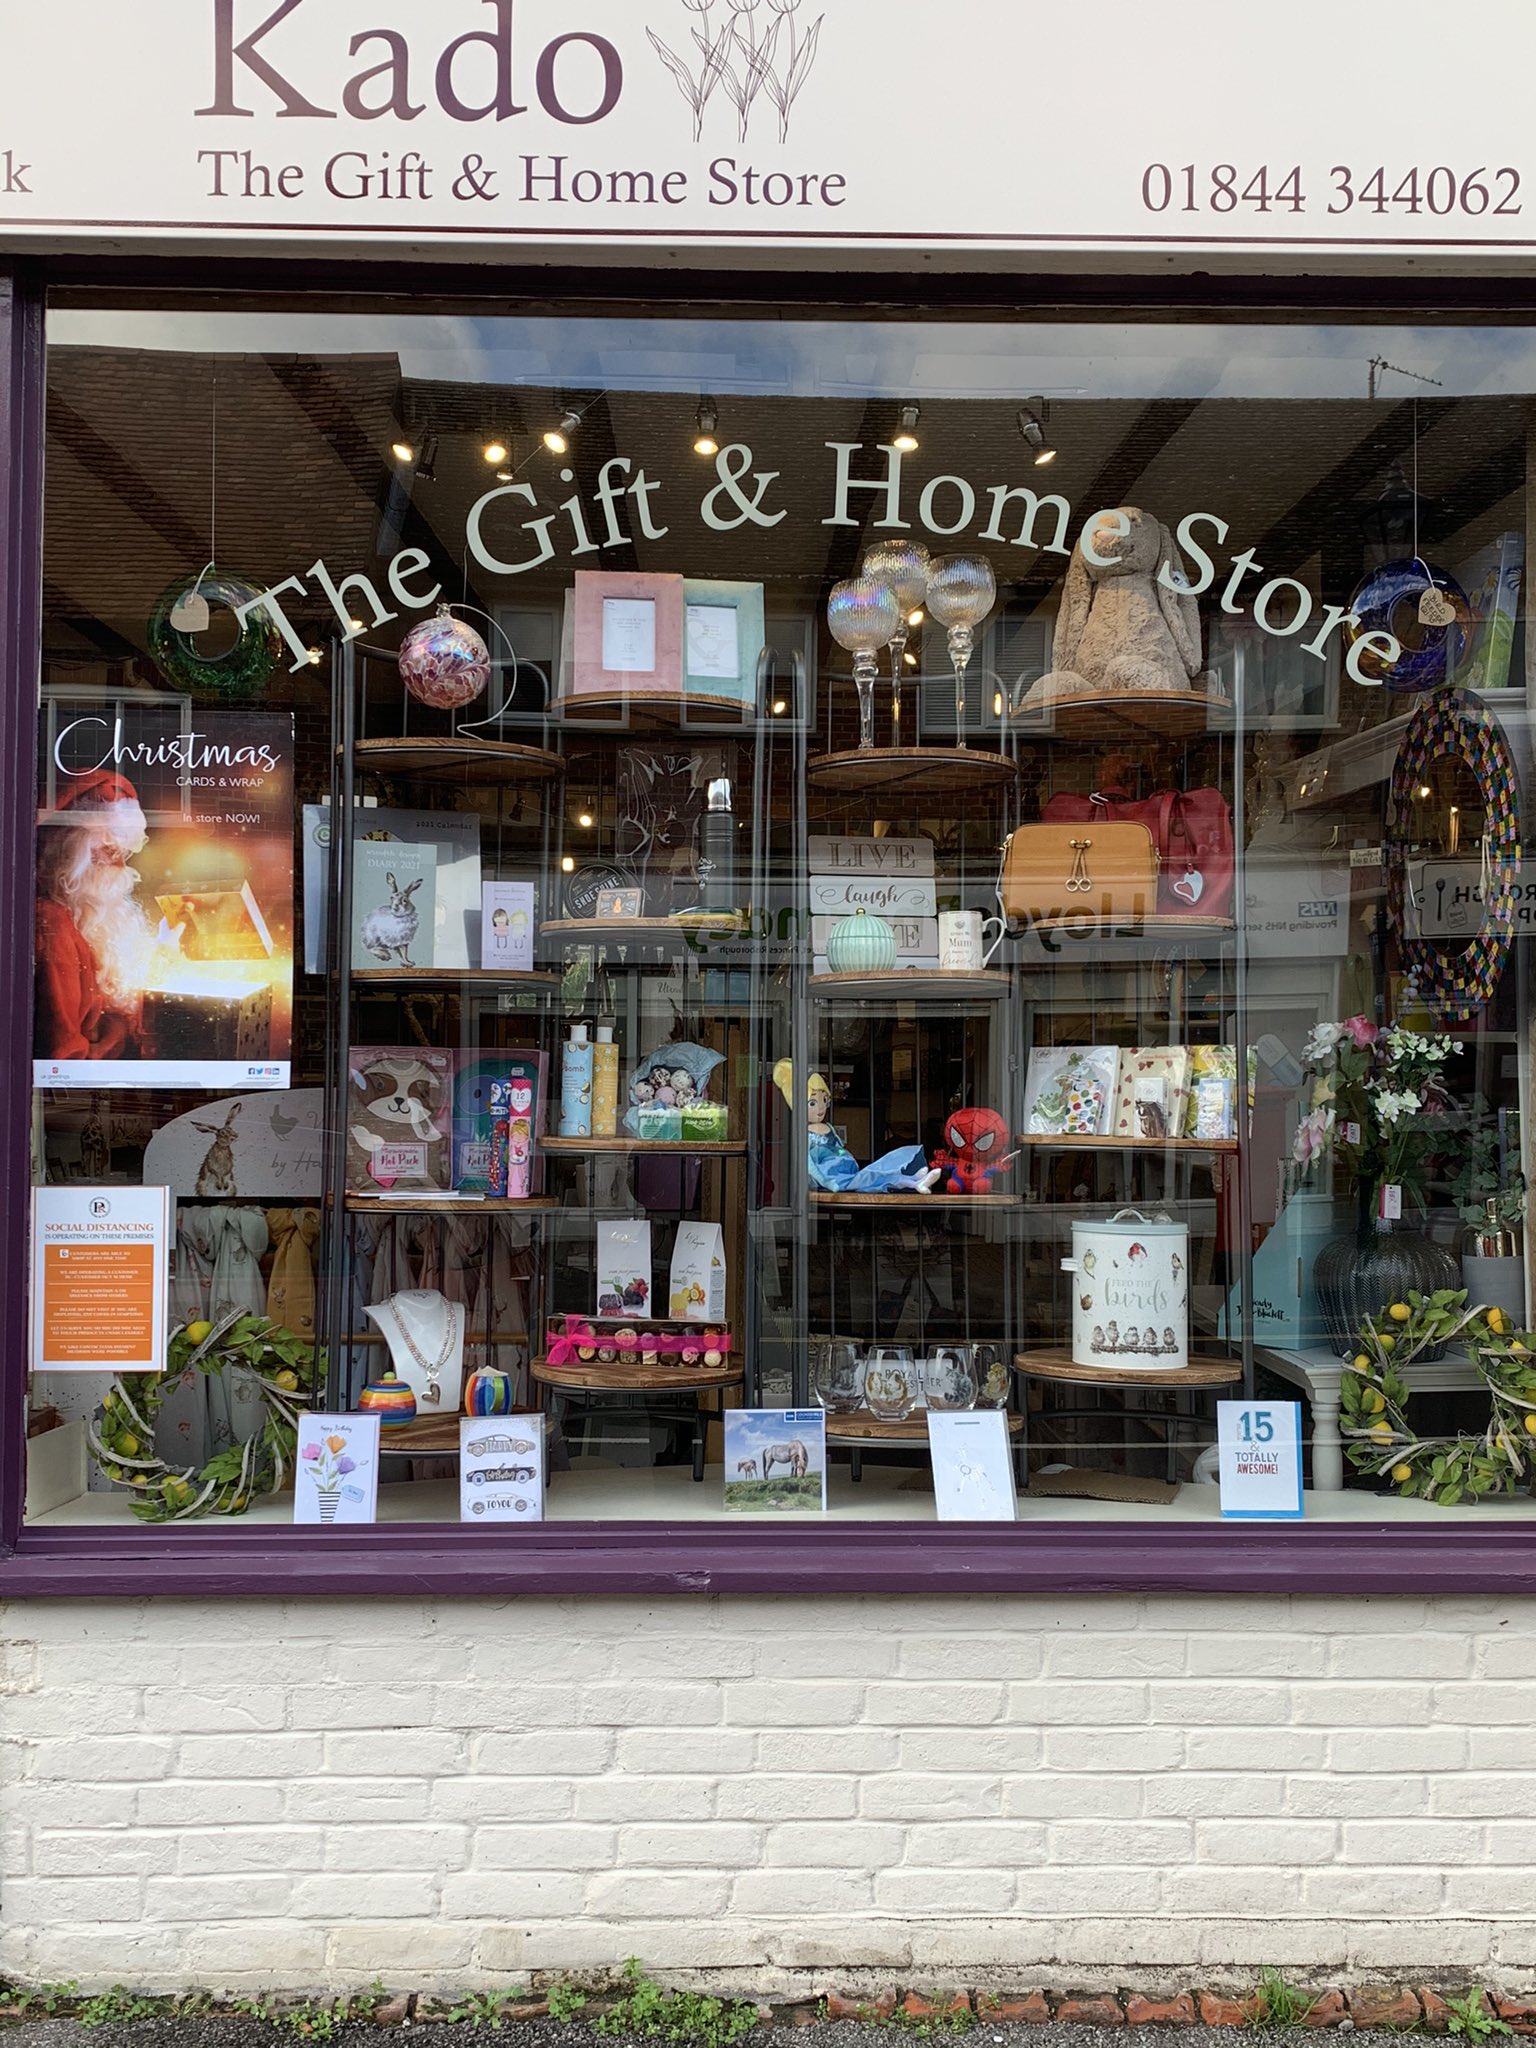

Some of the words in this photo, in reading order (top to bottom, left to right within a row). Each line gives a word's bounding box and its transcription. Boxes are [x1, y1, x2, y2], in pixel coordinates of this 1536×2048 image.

[194, 0, 625, 125] Kado
[198, 151, 304, 199] The
[324, 152, 433, 201] Gift
[451, 153, 500, 201] &
[518, 155, 688, 204] Home
[707, 158, 847, 207] Store
[1142, 163, 1307, 213] 01844
[1327, 165, 1523, 215] 344062
[235, 547, 442, 673] The
[466, 457, 669, 574] Gift
[701, 443, 788, 531] &
[821, 441, 1133, 567] Home
[1157, 512, 1401, 686] Store
[54, 716, 281, 776] Christmas
[176, 776, 215, 788] CARDS
[219, 777, 227, 788] &
[229, 777, 264, 788] WRAP
[182, 813, 192, 823] In
[195, 814, 222, 824] store
[225, 813, 261, 824] NOW!
[367, 859, 397, 868] DIARY
[400, 861, 420, 869] 2021
[827, 842, 916, 869] LIVE
[574, 890, 597, 909] SHOE
[271, 1152, 286, 1177] by
[45, 1223, 84, 1232] SOCIAL
[86, 1223, 154, 1232] DISTANCING
[1104, 1277, 1169, 1314] birds
[1240, 1411, 1274, 1442] 15
[1235, 1452, 1279, 1463] TOTALLY
[1250, 1440, 1260, 1452] &
[1236, 1463, 1279, 1475] AWESOME!
